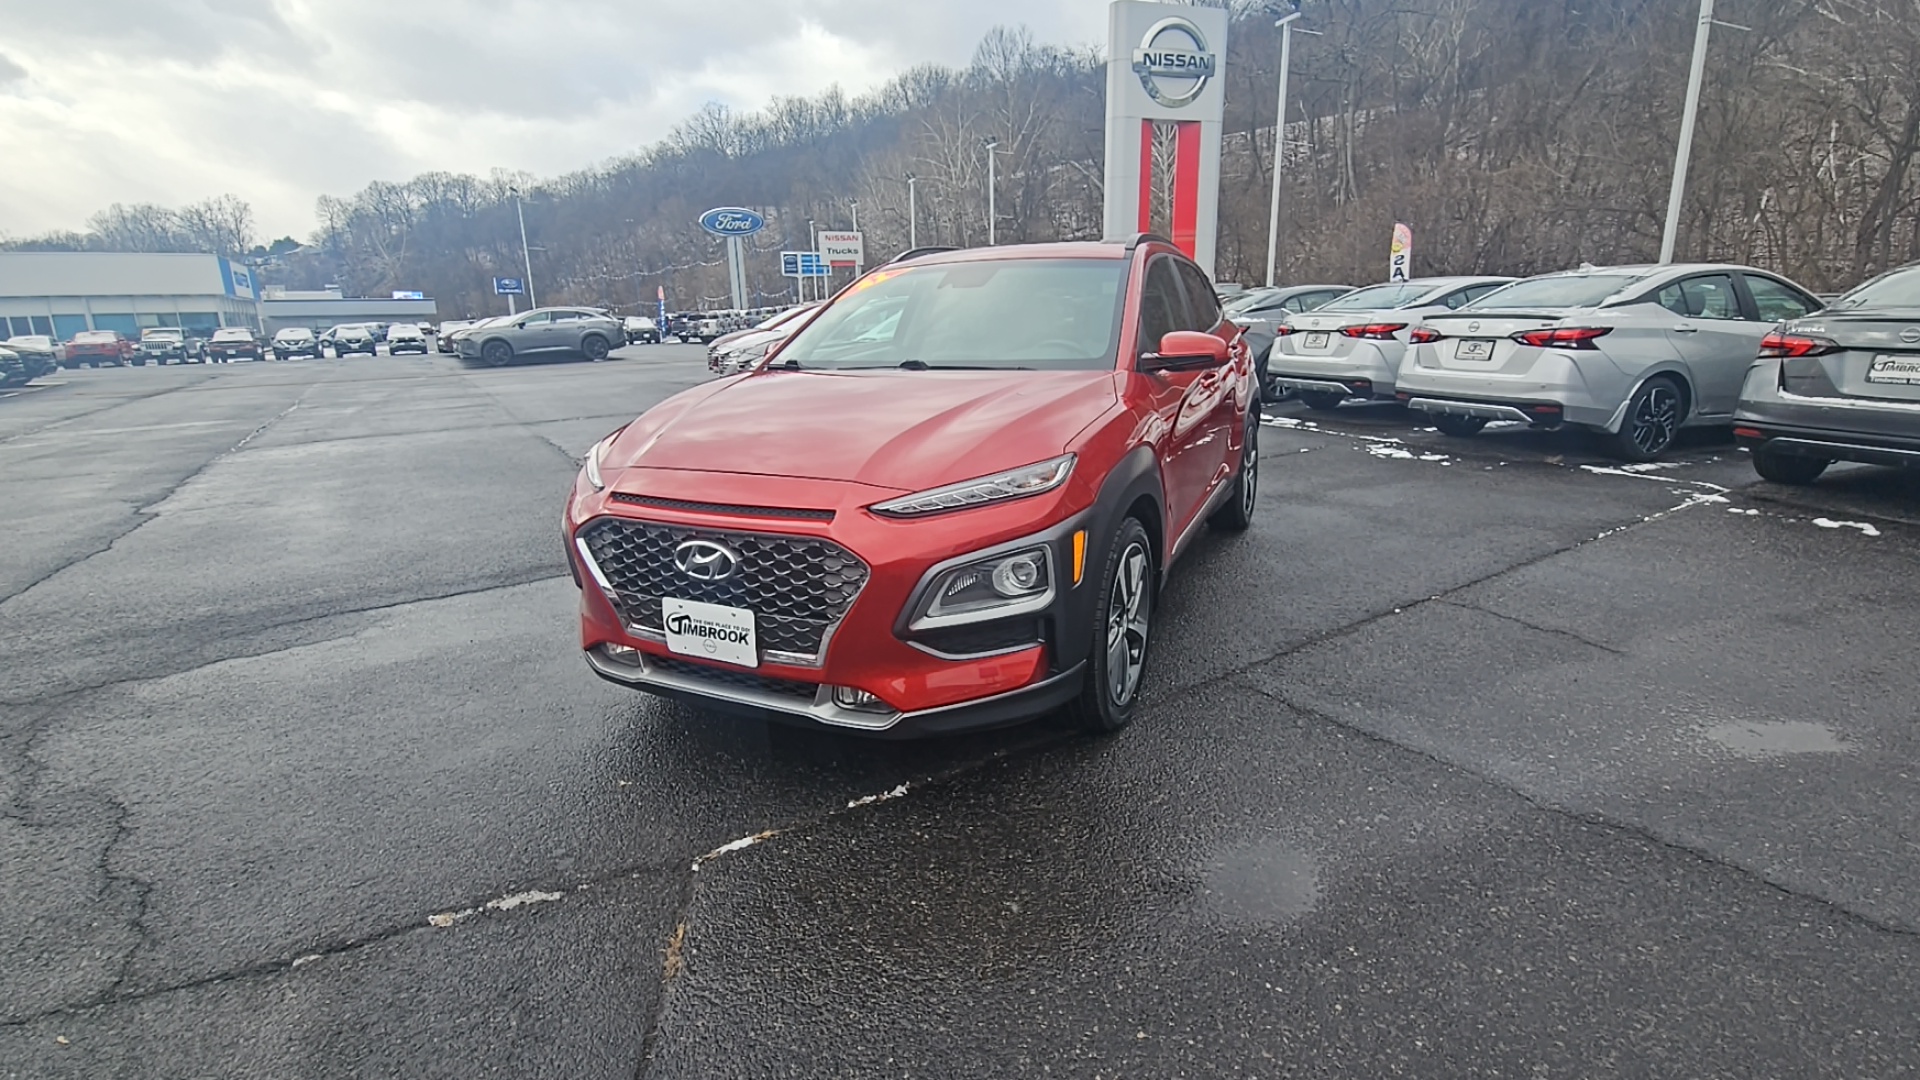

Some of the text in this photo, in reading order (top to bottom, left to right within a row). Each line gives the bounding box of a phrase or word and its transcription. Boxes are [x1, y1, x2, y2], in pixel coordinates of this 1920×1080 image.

[1143, 52, 1210, 70] NISSAN
[715, 212, 752, 230] Ford
[825, 234, 859, 242] NISSAN
[827, 247, 859, 255] Trucks
[666, 612, 749, 646] TIMBROOK
[715, 622, 731, 630] PLACE
